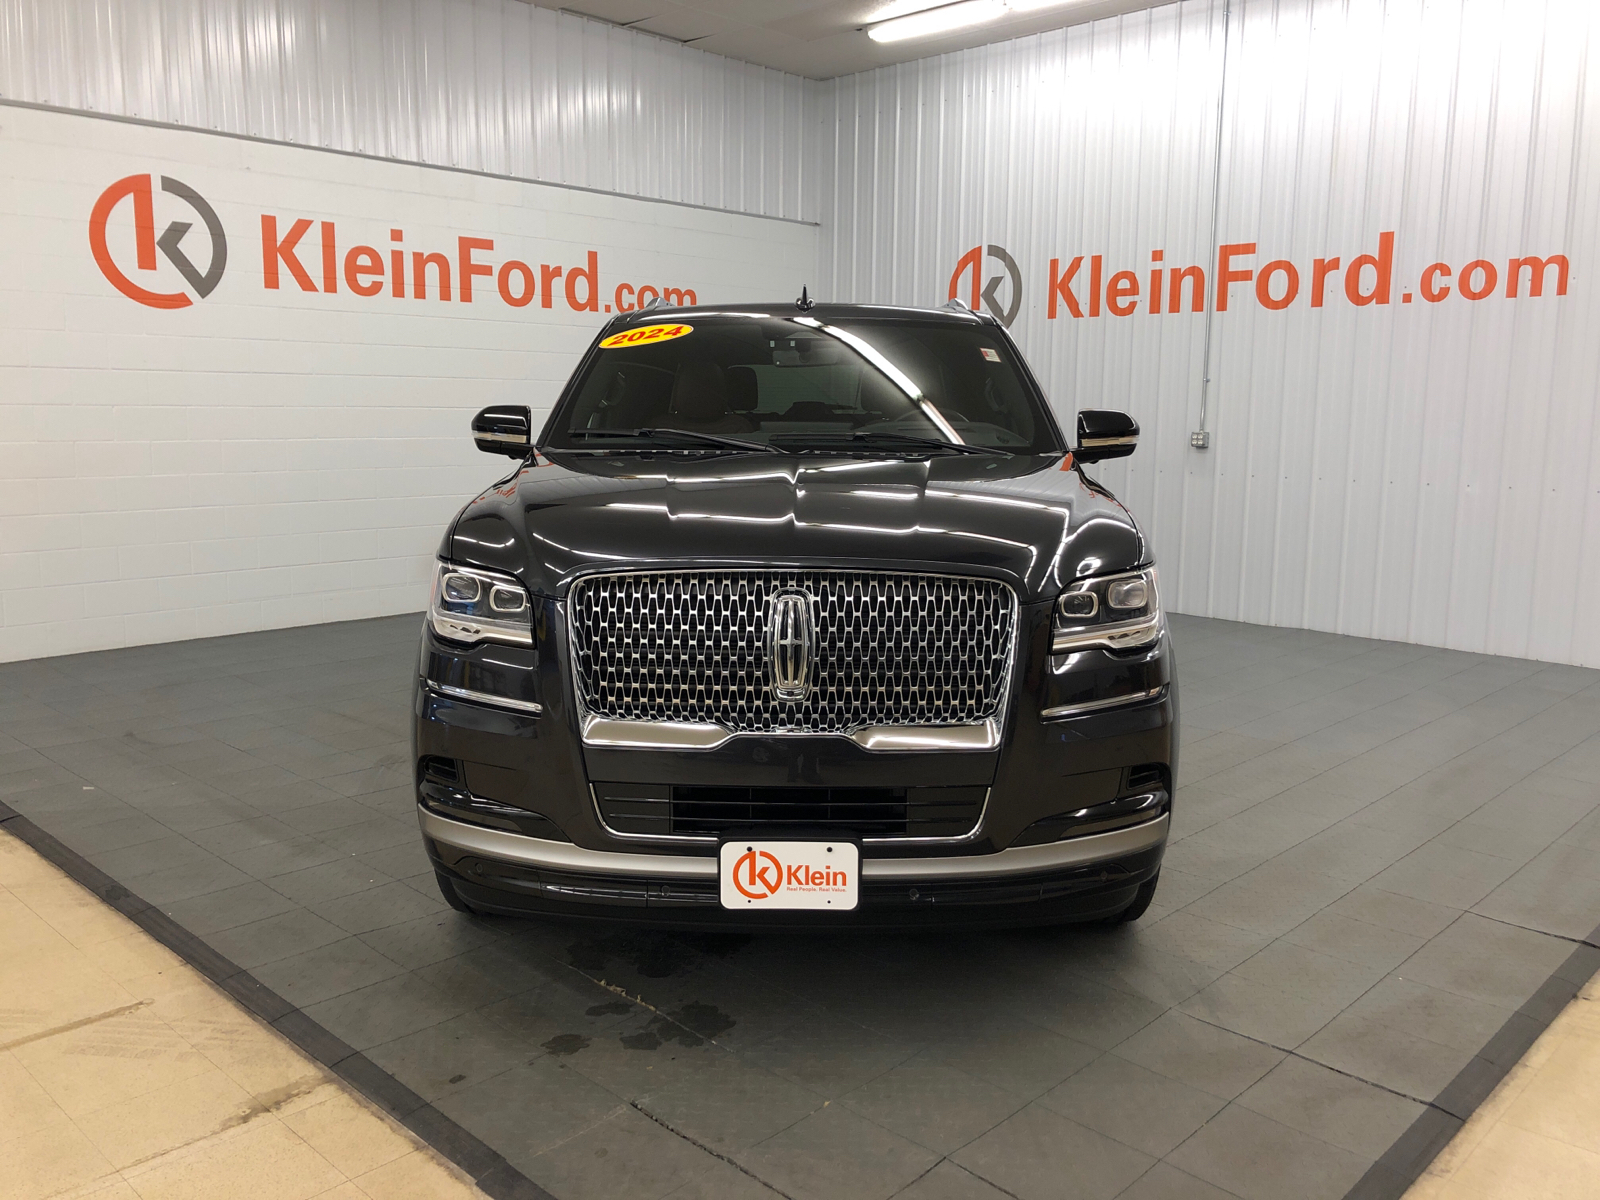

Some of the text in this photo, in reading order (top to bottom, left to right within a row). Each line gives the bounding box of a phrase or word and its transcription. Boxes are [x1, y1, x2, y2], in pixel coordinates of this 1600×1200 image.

[262, 215, 697, 314] KleinFord.com
[1047, 232, 1569, 320] KleinFord.com
[606, 326, 685, 347] 2024
[786, 864, 847, 886] Klein
